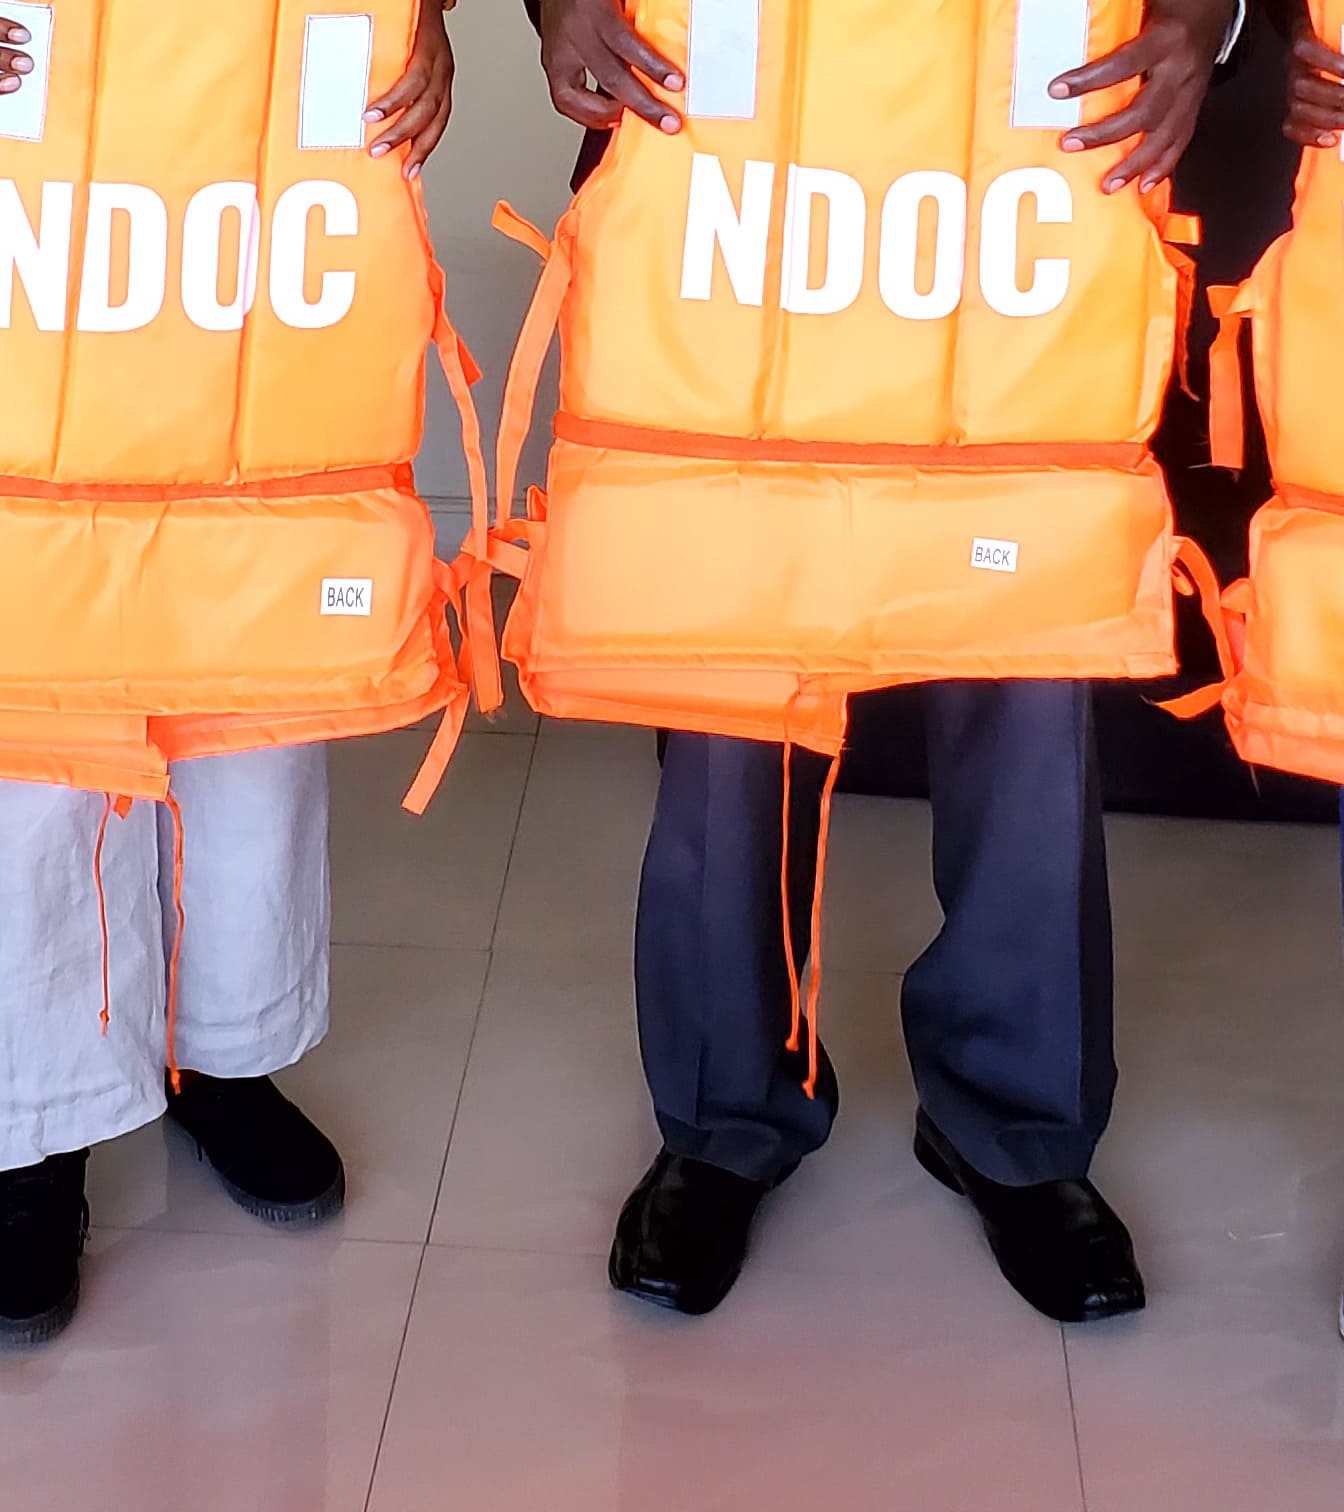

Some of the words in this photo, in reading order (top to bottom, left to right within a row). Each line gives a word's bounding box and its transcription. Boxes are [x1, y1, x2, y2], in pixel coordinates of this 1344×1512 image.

[679, 150, 1074, 321] NDOC
[974, 546, 1011, 566] BACK
[327, 586, 365, 608] BACK
